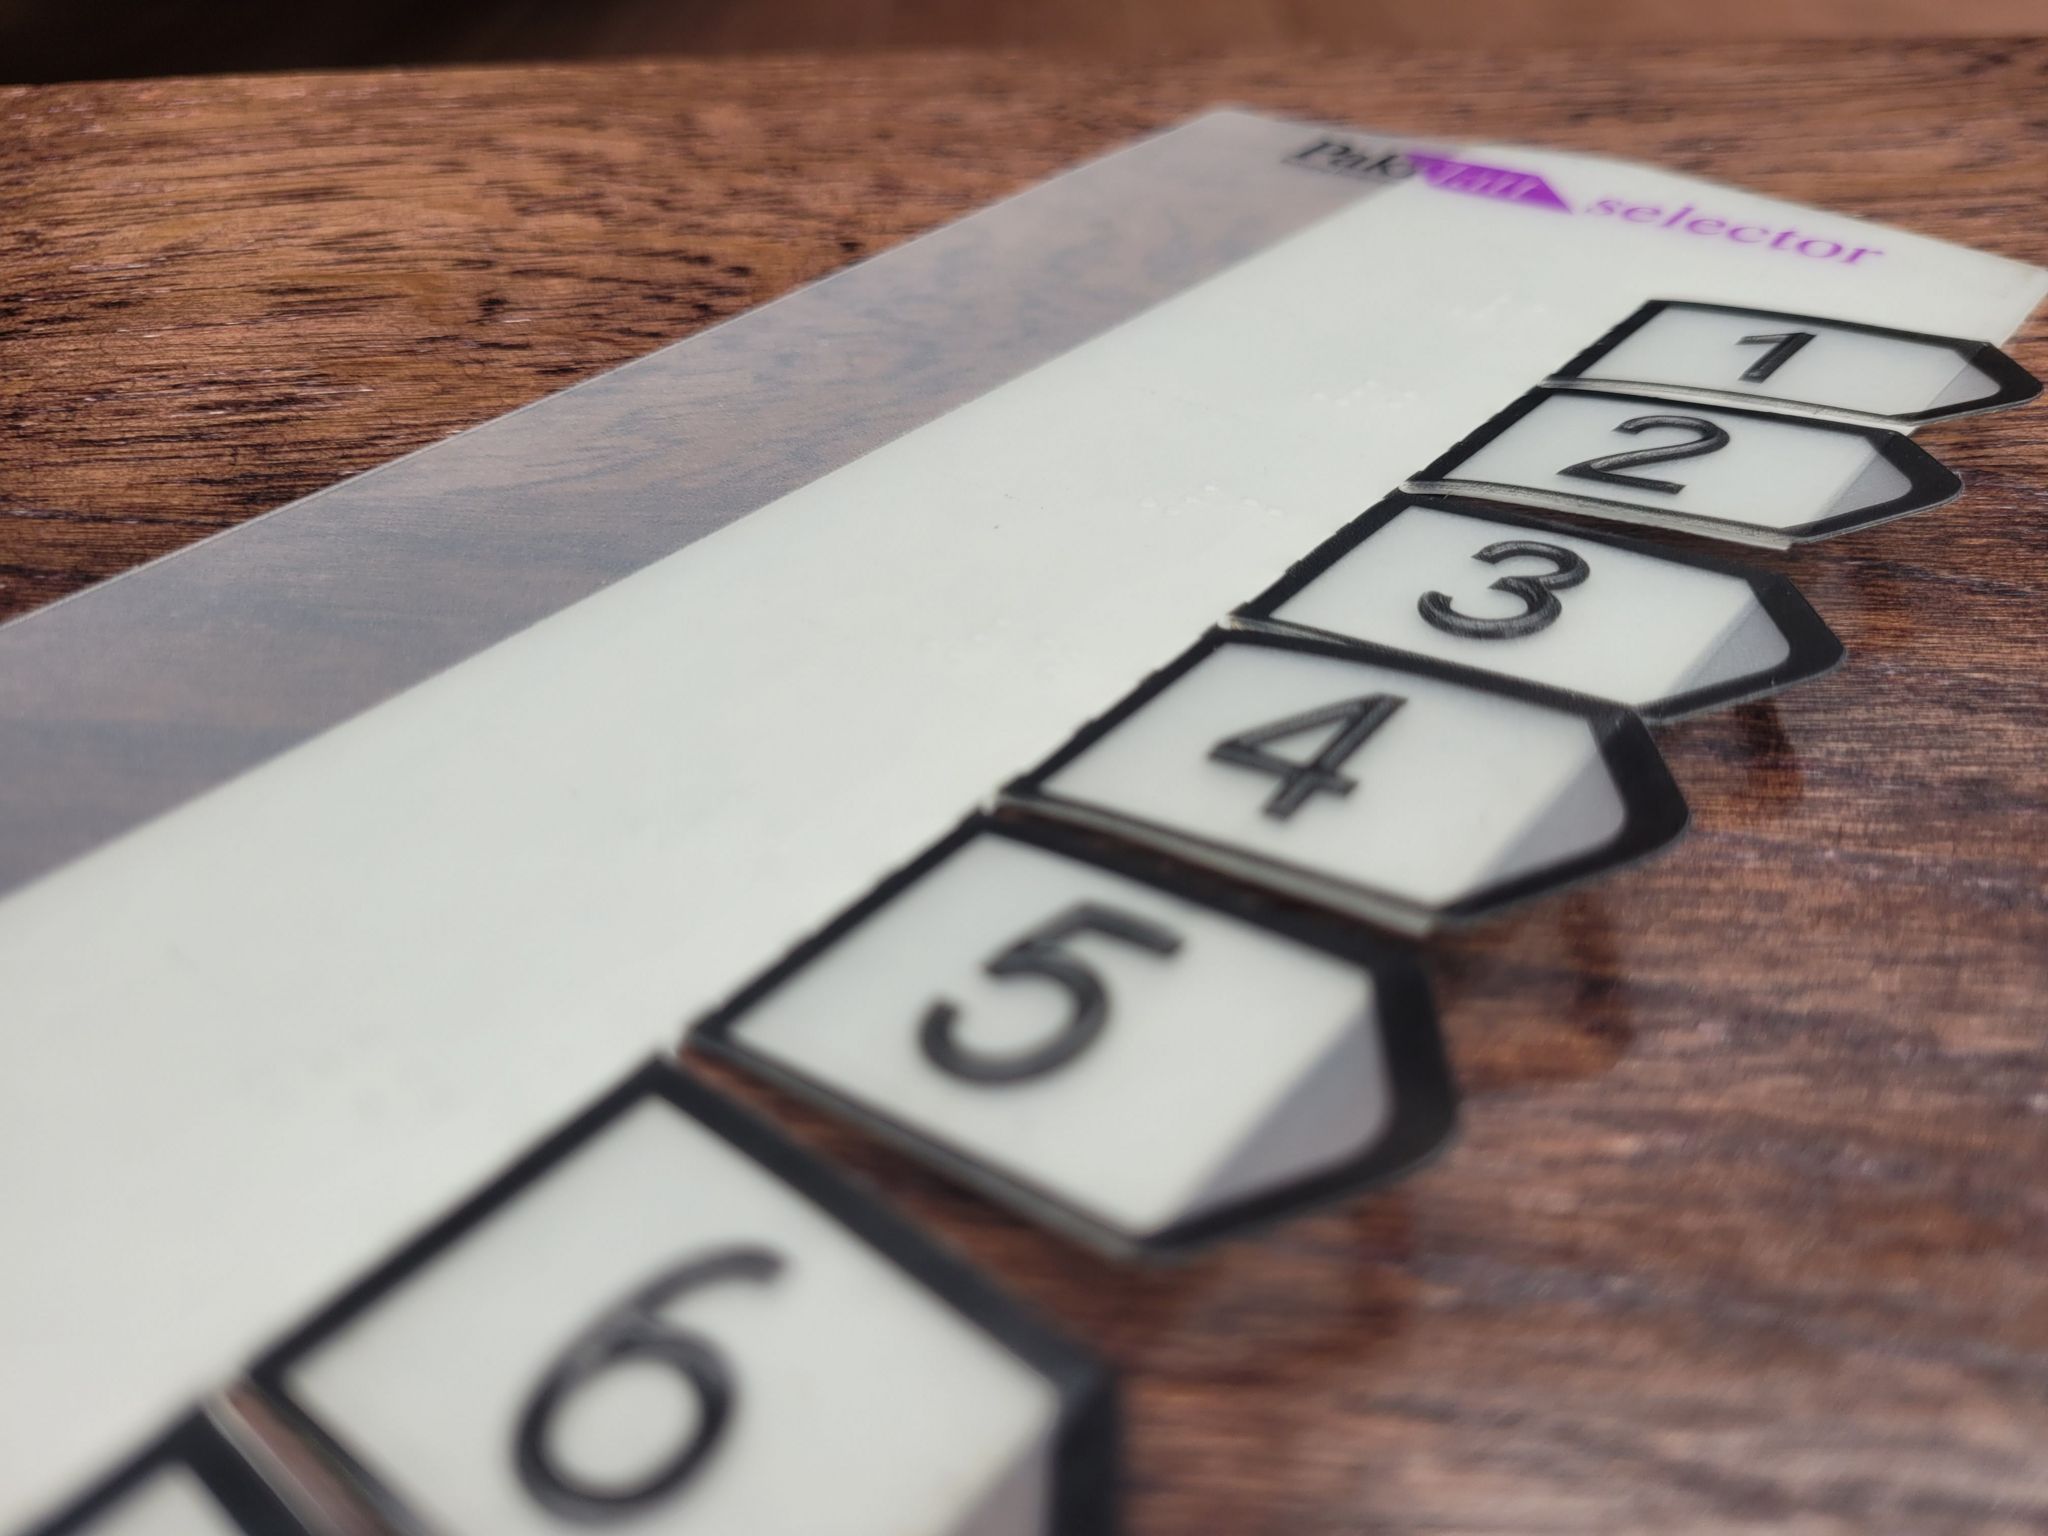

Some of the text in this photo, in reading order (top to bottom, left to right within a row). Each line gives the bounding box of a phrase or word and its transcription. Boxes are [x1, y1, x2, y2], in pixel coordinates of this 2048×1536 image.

[1586, 194, 1885, 264] selector
[1735, 331, 1818, 383] 1
[1558, 415, 1730, 495] 2
[1417, 540, 1590, 641] 3
[1208, 693, 1408, 821] 4
[917, 901, 1186, 1087] 5
[512, 1244, 790, 1530] 6
